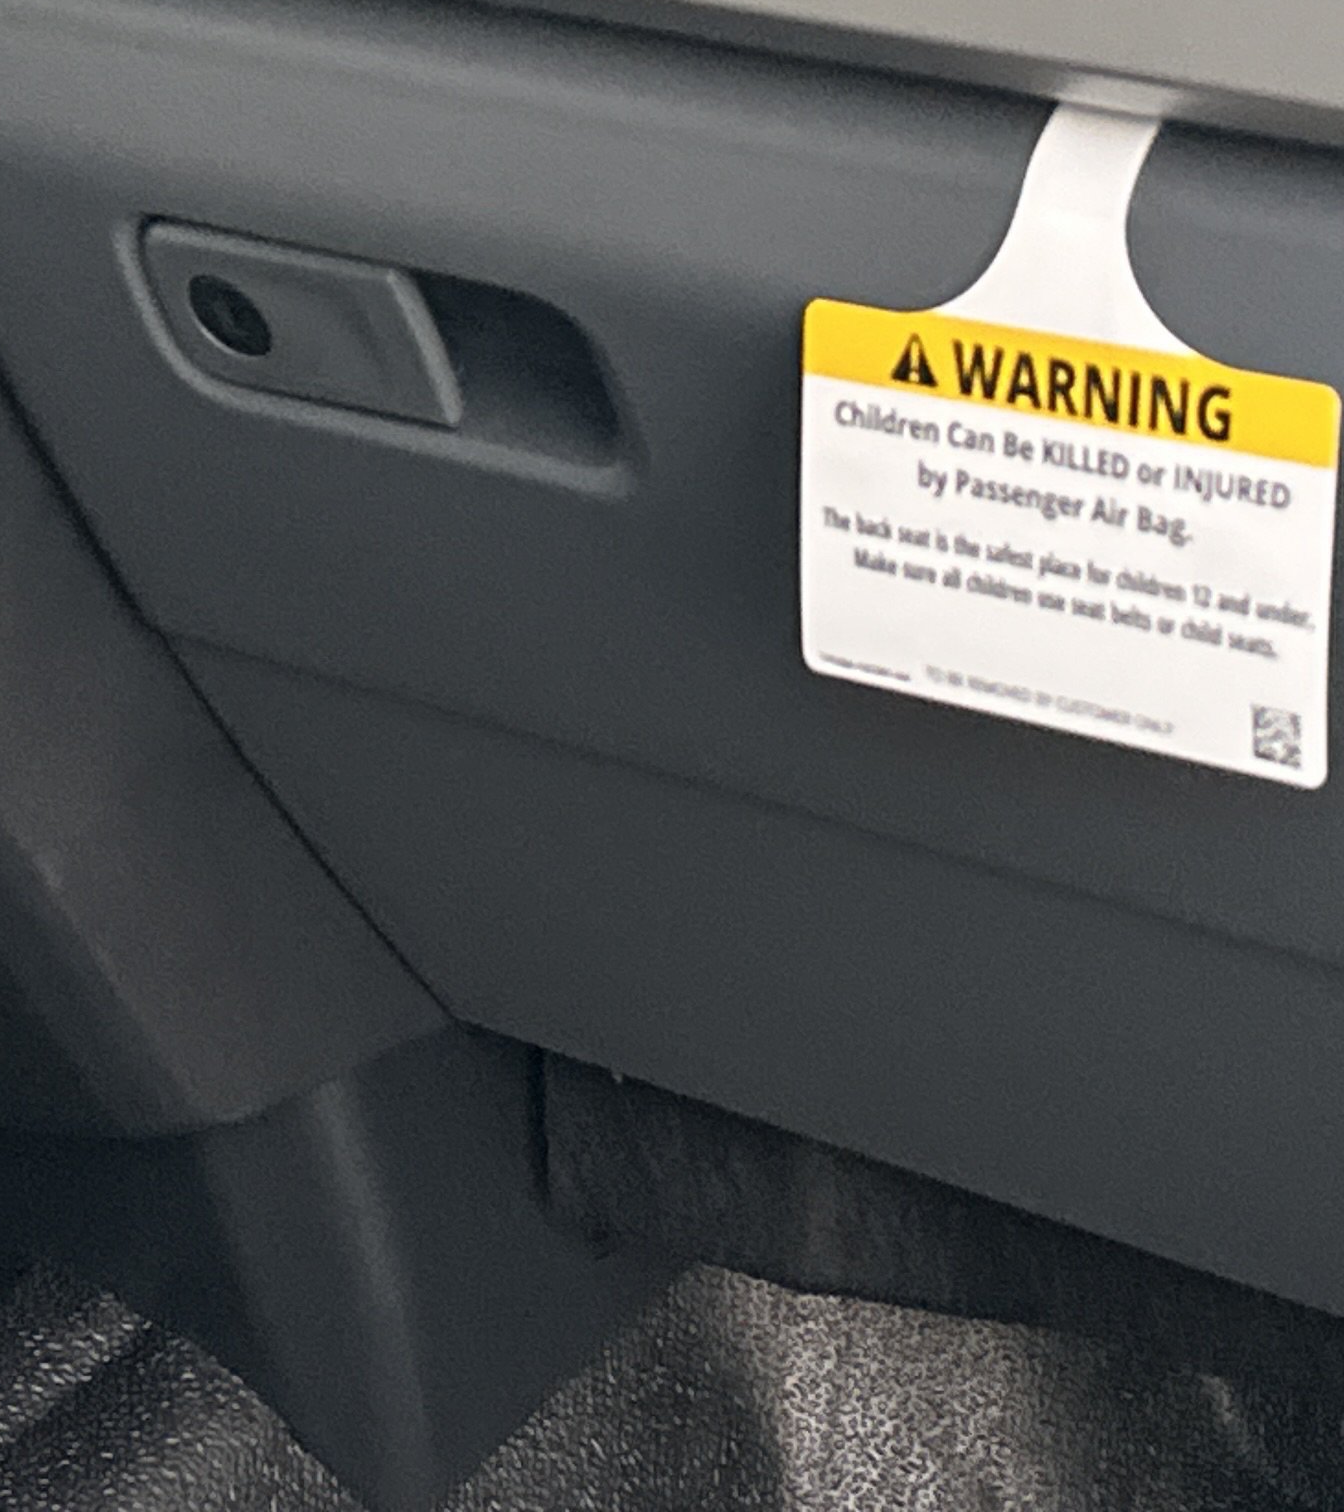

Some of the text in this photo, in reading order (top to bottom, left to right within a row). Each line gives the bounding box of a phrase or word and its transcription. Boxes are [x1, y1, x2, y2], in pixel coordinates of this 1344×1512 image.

[952, 338, 1233, 443] WARNING
[834, 400, 1293, 511] Children Can Be KILLED or INJURED
[917, 458, 1193, 548] by Passenger Air Bag.
[822, 505, 851, 532] The
[856, 511, 893, 540] back
[897, 525, 931, 548] seat
[935, 528, 949, 553] is
[953, 533, 981, 560] the
[985, 541, 1034, 570] safest
[1039, 551, 1082, 581] place
[1086, 559, 1111, 586] for
[1115, 568, 1188, 602] children
[1217, 592, 1251, 617] and
[853, 545, 898, 578] Make
[902, 561, 937, 585] sure
[942, 566, 962, 590] all
[966, 571, 1034, 606] children
[1071, 597, 1106, 622] seat
[1110, 600, 1152, 632] belts
[1180, 617, 1224, 647] child
